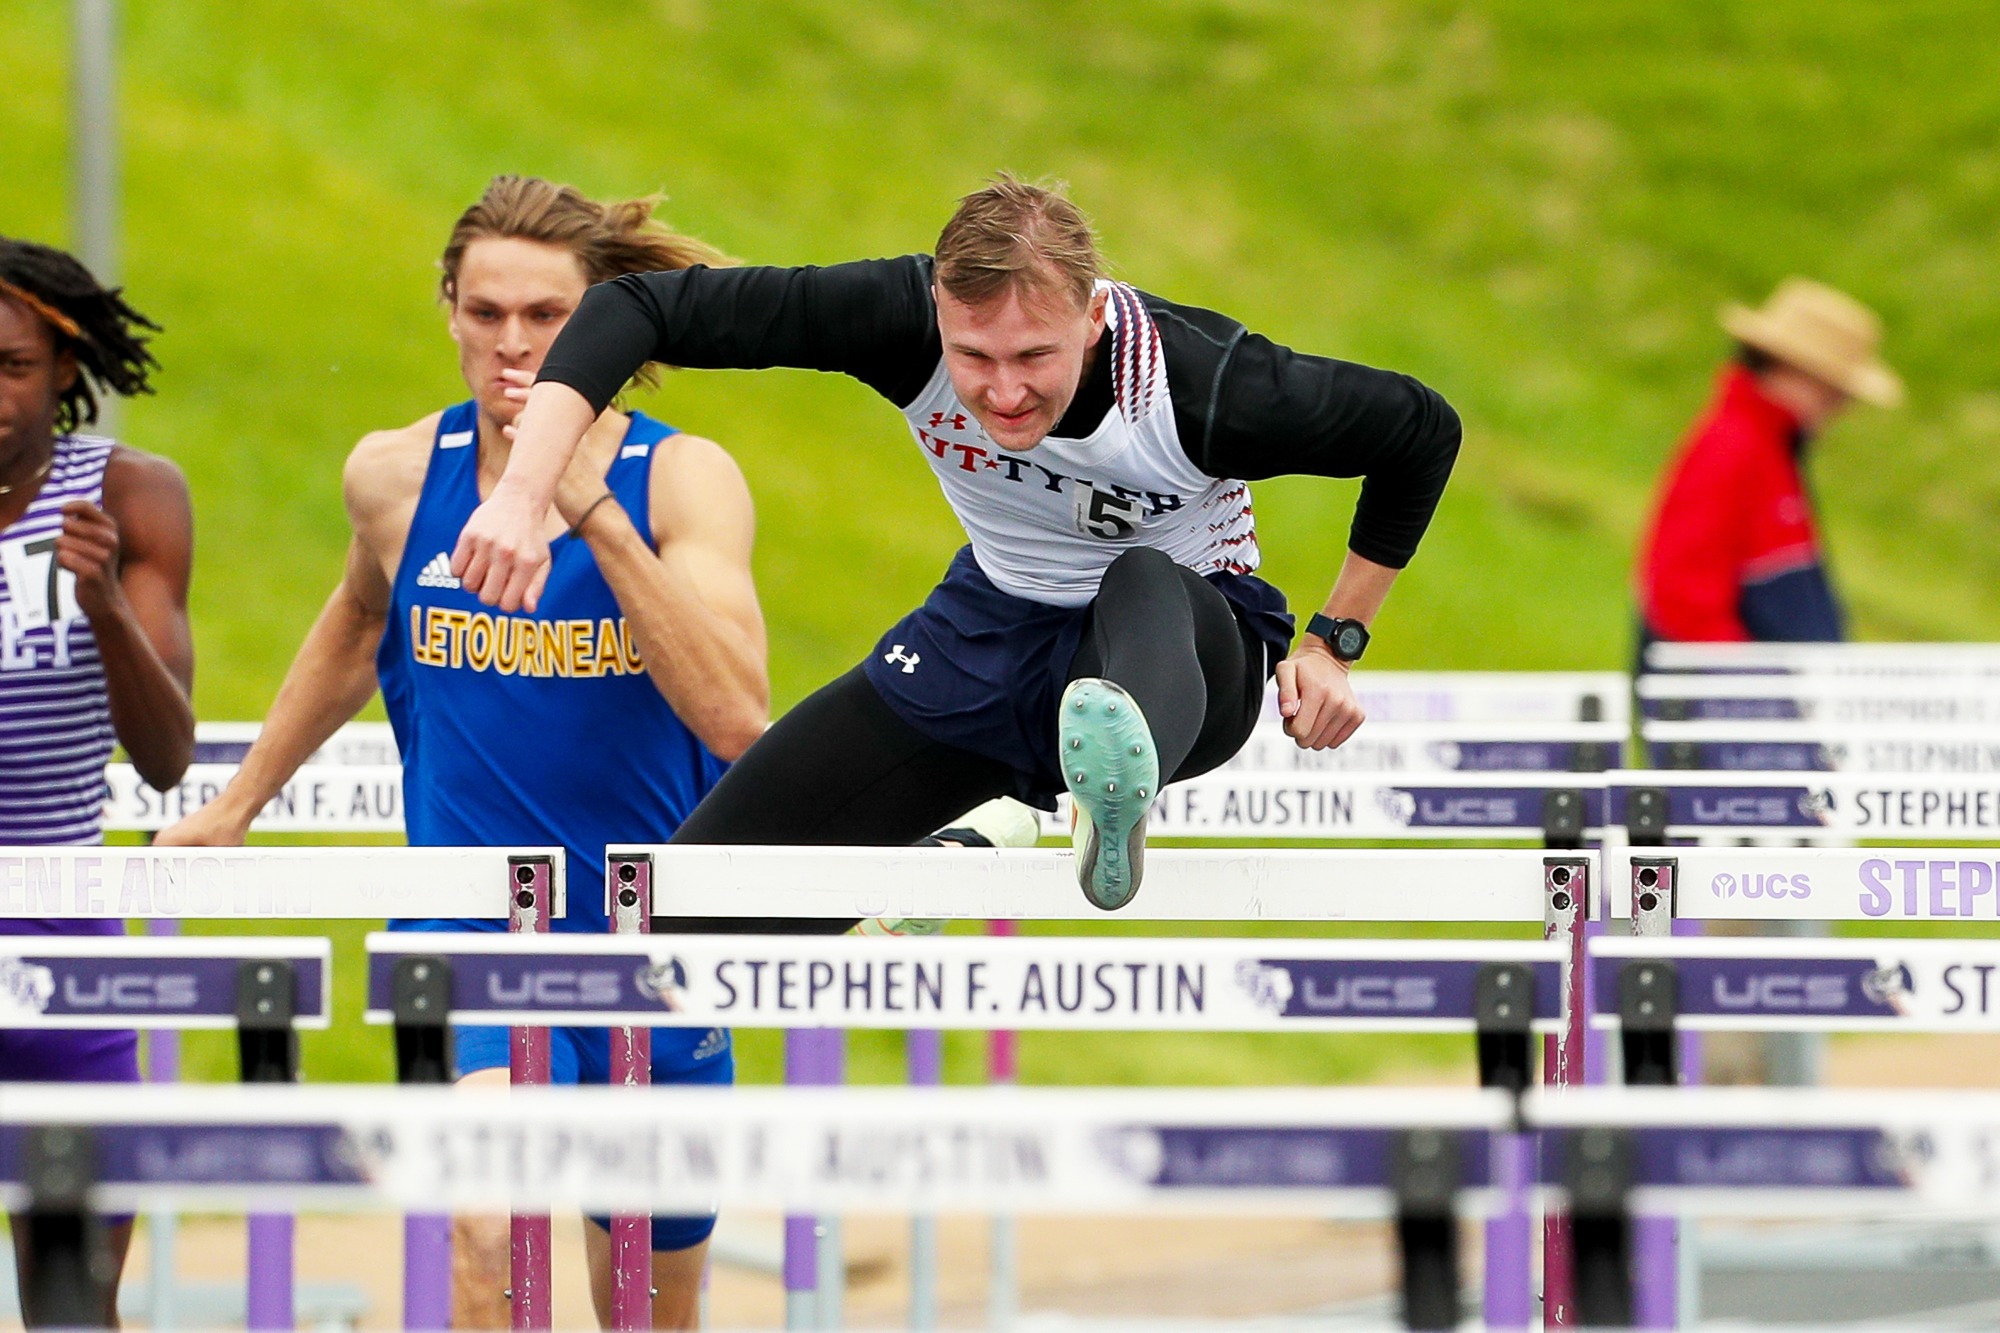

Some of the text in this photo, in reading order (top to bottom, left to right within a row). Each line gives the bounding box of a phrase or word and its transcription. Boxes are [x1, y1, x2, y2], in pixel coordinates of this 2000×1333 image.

[917, 427, 1186, 516] UT TYR
[1087, 489, 1136, 541] 5
[24, 538, 60, 621] 7
[134, 783, 295, 818] STEPN
[313, 784, 336, 818] F.
[1185, 789, 1209, 824] F.
[1222, 789, 1353, 825] AUSTIN
[1421, 799, 1517, 824] UCS
[1693, 797, 1788, 823] UCS
[1856, 790, 2000, 826] STEPHE
[1742, 873, 1812, 900] UCS
[1858, 858, 2000, 917] STEP
[64, 973, 199, 1008] UCS
[487, 970, 622, 1004] UCS
[714, 960, 944, 1012] STEPHEN
[967, 961, 999, 1011] F.
[1018, 962, 1207, 1014] AUSTIN
[1303, 977, 1438, 1010] UCS
[1712, 973, 1848, 1009] UCS
